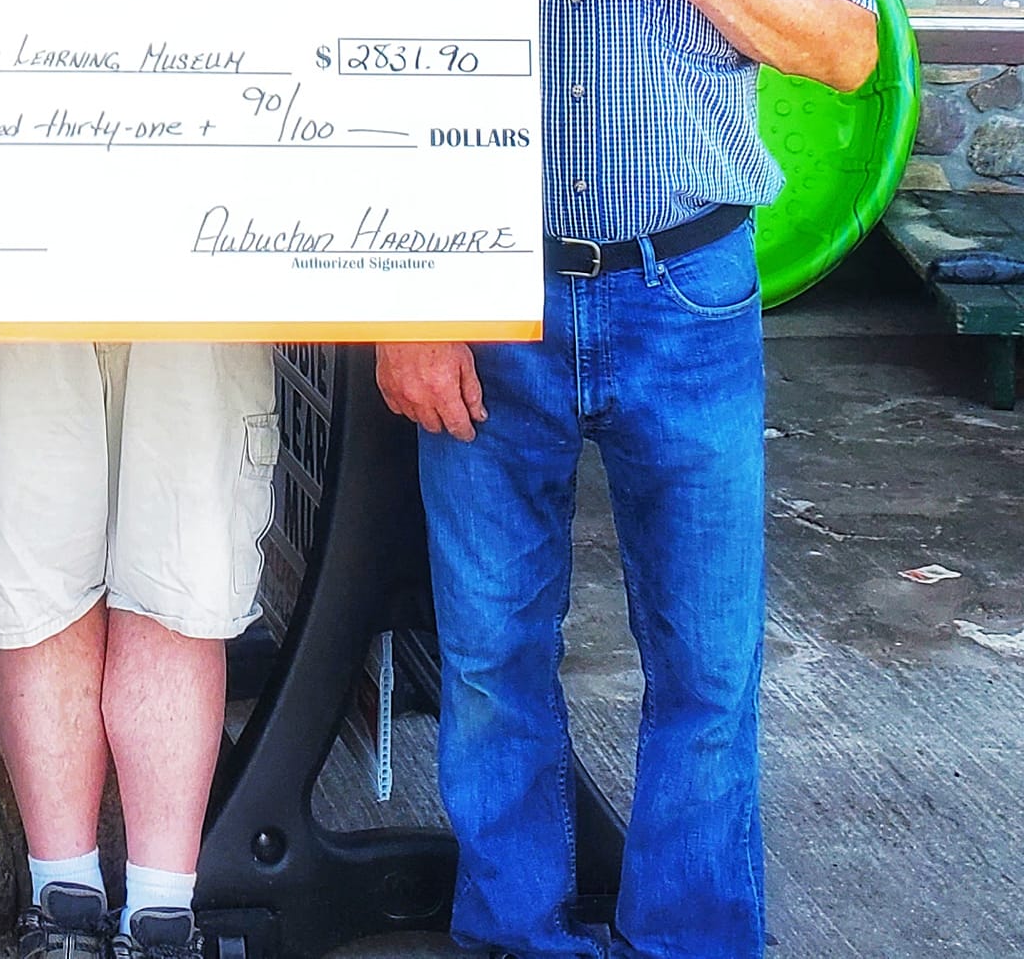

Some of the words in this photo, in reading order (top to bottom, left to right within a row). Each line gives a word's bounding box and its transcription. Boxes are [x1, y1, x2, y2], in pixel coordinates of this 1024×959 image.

[348, 44, 479, 73] 2831.90
[430, 127, 531, 148] DOLLARS
[291, 257, 365, 270] Authorized
[369, 256, 435, 272] Signature
